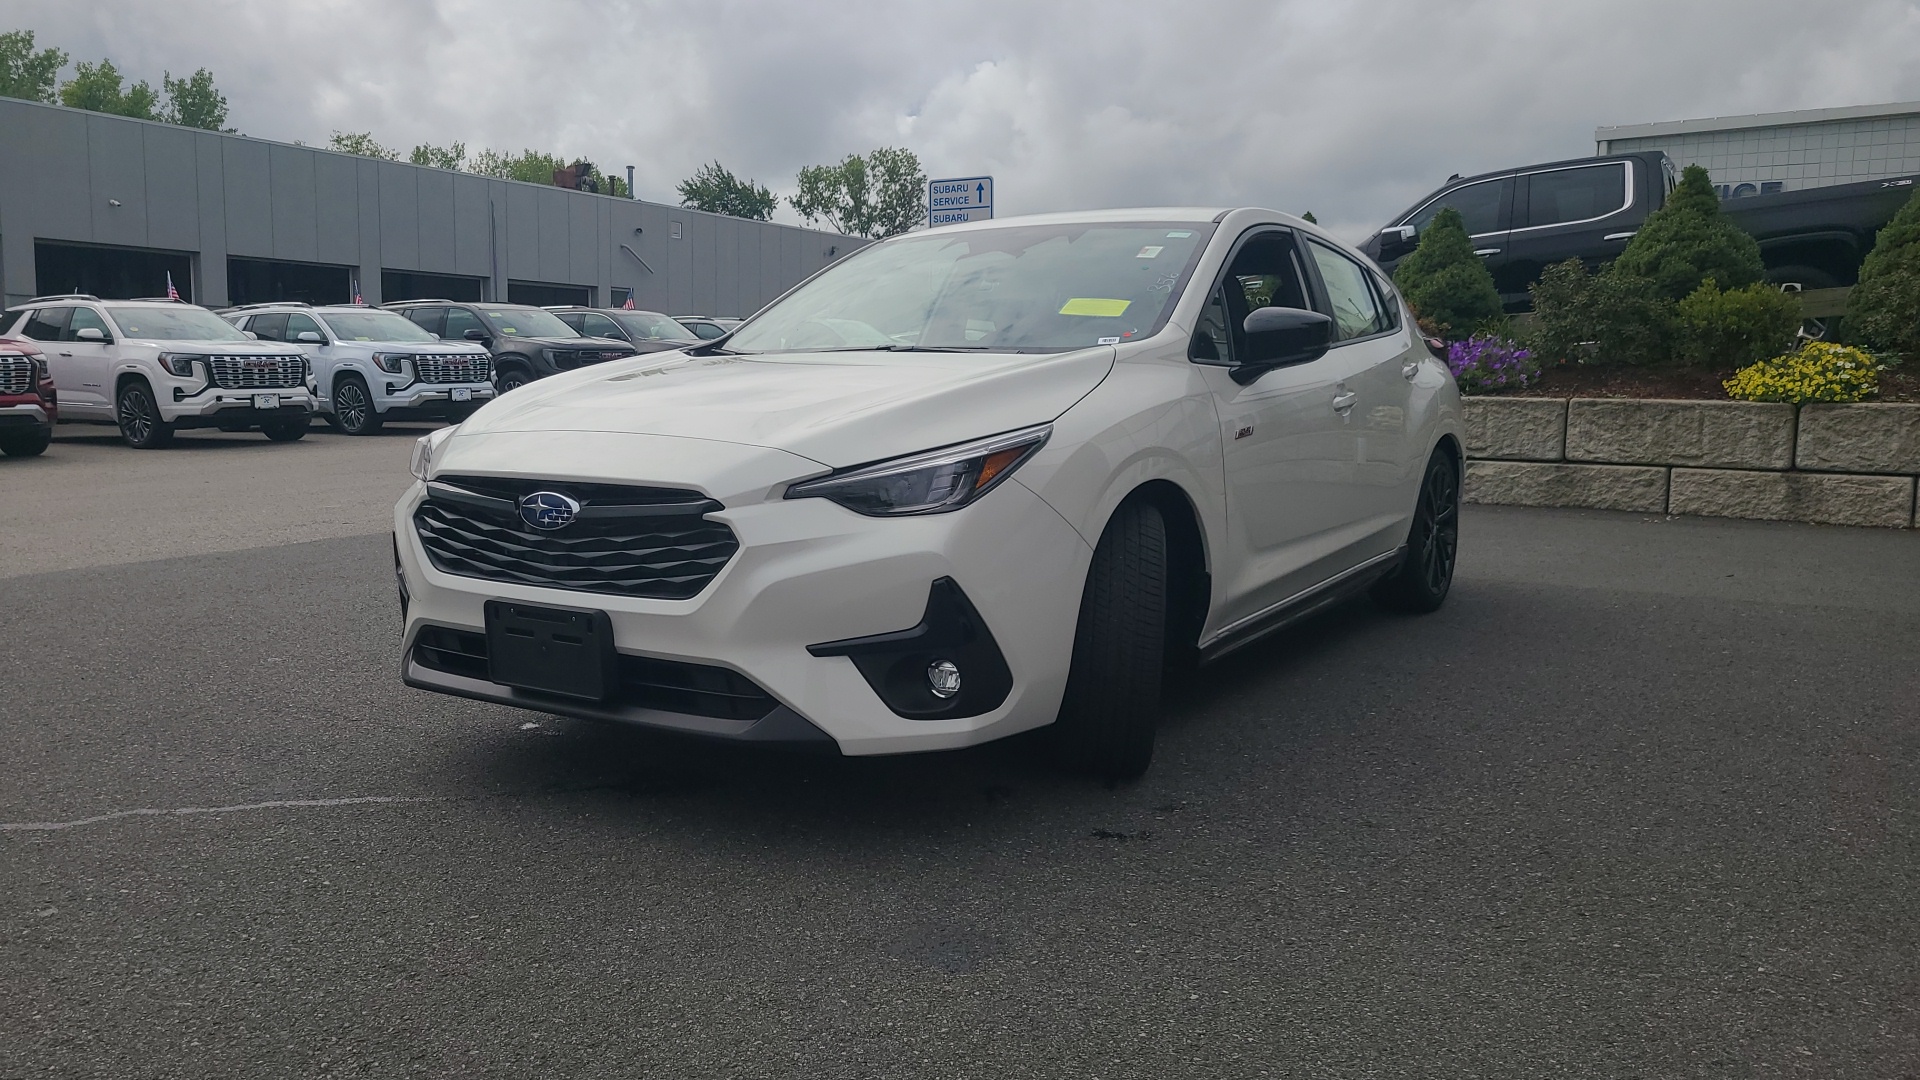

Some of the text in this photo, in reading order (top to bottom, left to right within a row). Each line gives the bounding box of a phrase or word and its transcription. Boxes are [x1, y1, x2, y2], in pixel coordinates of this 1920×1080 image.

[933, 184, 969, 195] SUBARU
[933, 196, 970, 207] SERVICE
[933, 213, 969, 223] SUBARU
